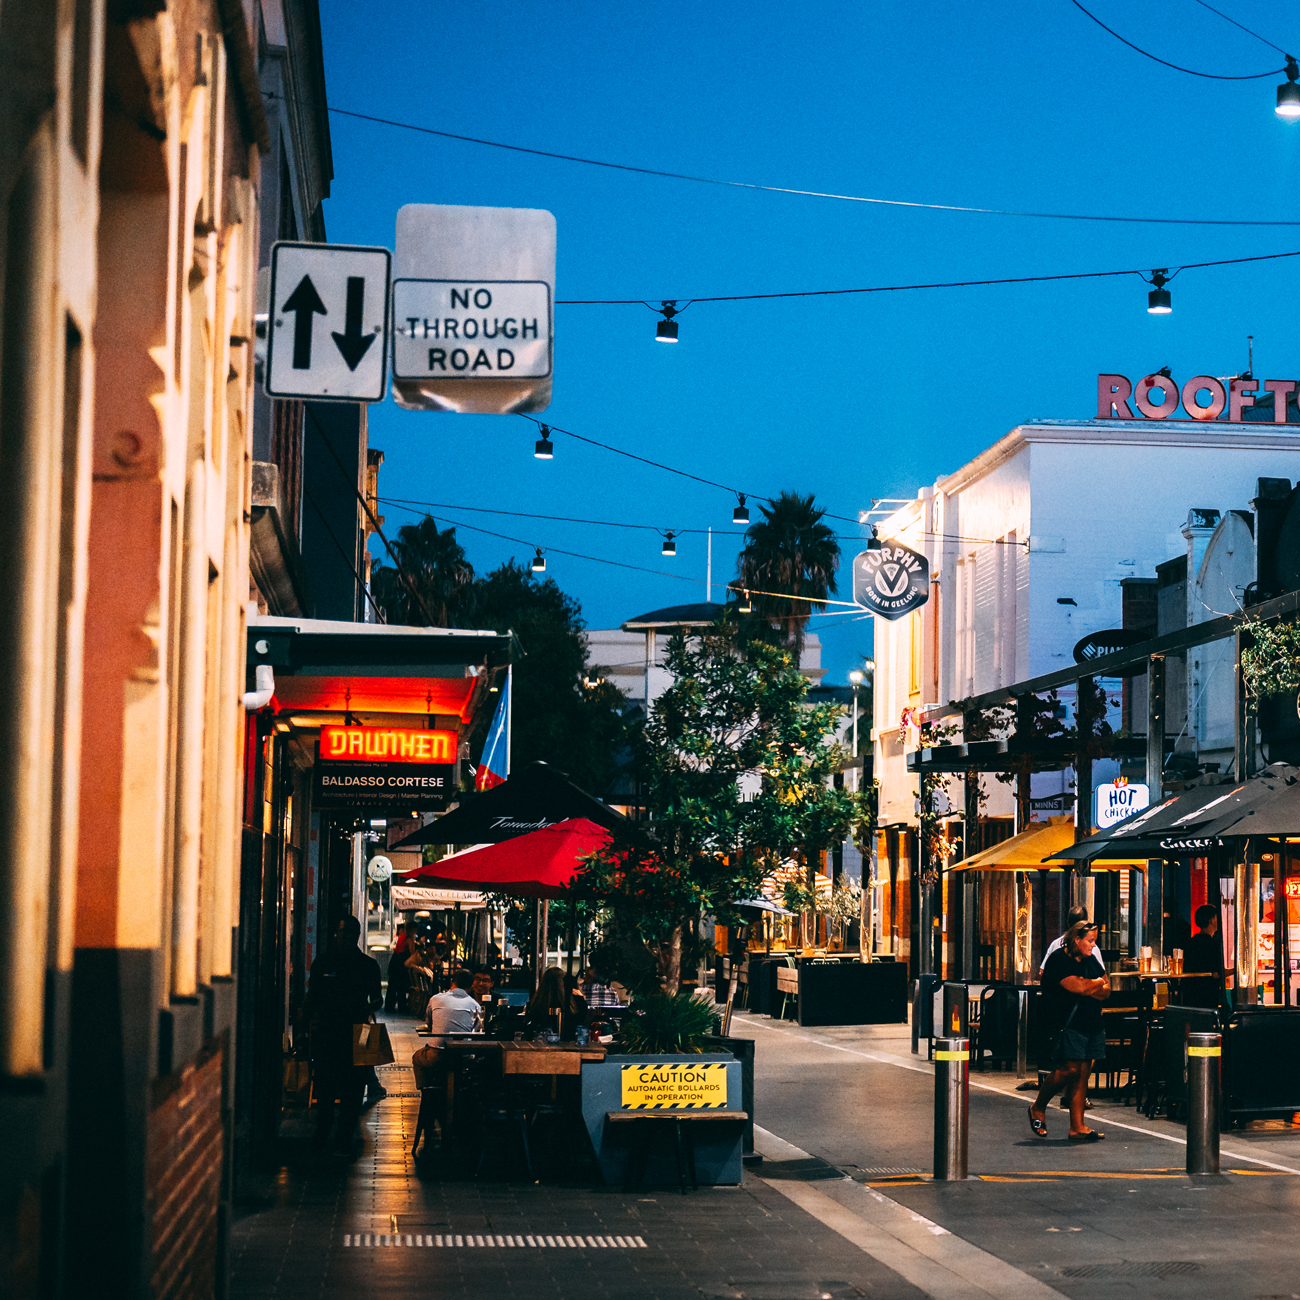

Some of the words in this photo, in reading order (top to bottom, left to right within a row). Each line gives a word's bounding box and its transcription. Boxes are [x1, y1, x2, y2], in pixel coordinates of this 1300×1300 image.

[450, 287, 493, 310] NO
[405, 317, 538, 340] THROUGH
[427, 347, 516, 371] ROAD
[861, 547, 923, 574] FURPHY
[865, 585, 882, 604] BORN
[881, 599, 890, 608] IN
[890, 585, 919, 608] GEELONG
[1097, 646, 1124, 658] PIA
[329, 730, 449, 759] DRUNKEN
[322, 776, 385, 787] BALDASSO
[387, 777, 444, 787] CORTESE
[380, 792, 397, 800] Design
[1034, 801, 1059, 810] MINNS
[1108, 788, 1138, 807] HOT
[638, 1072, 707, 1083] CAUTION
